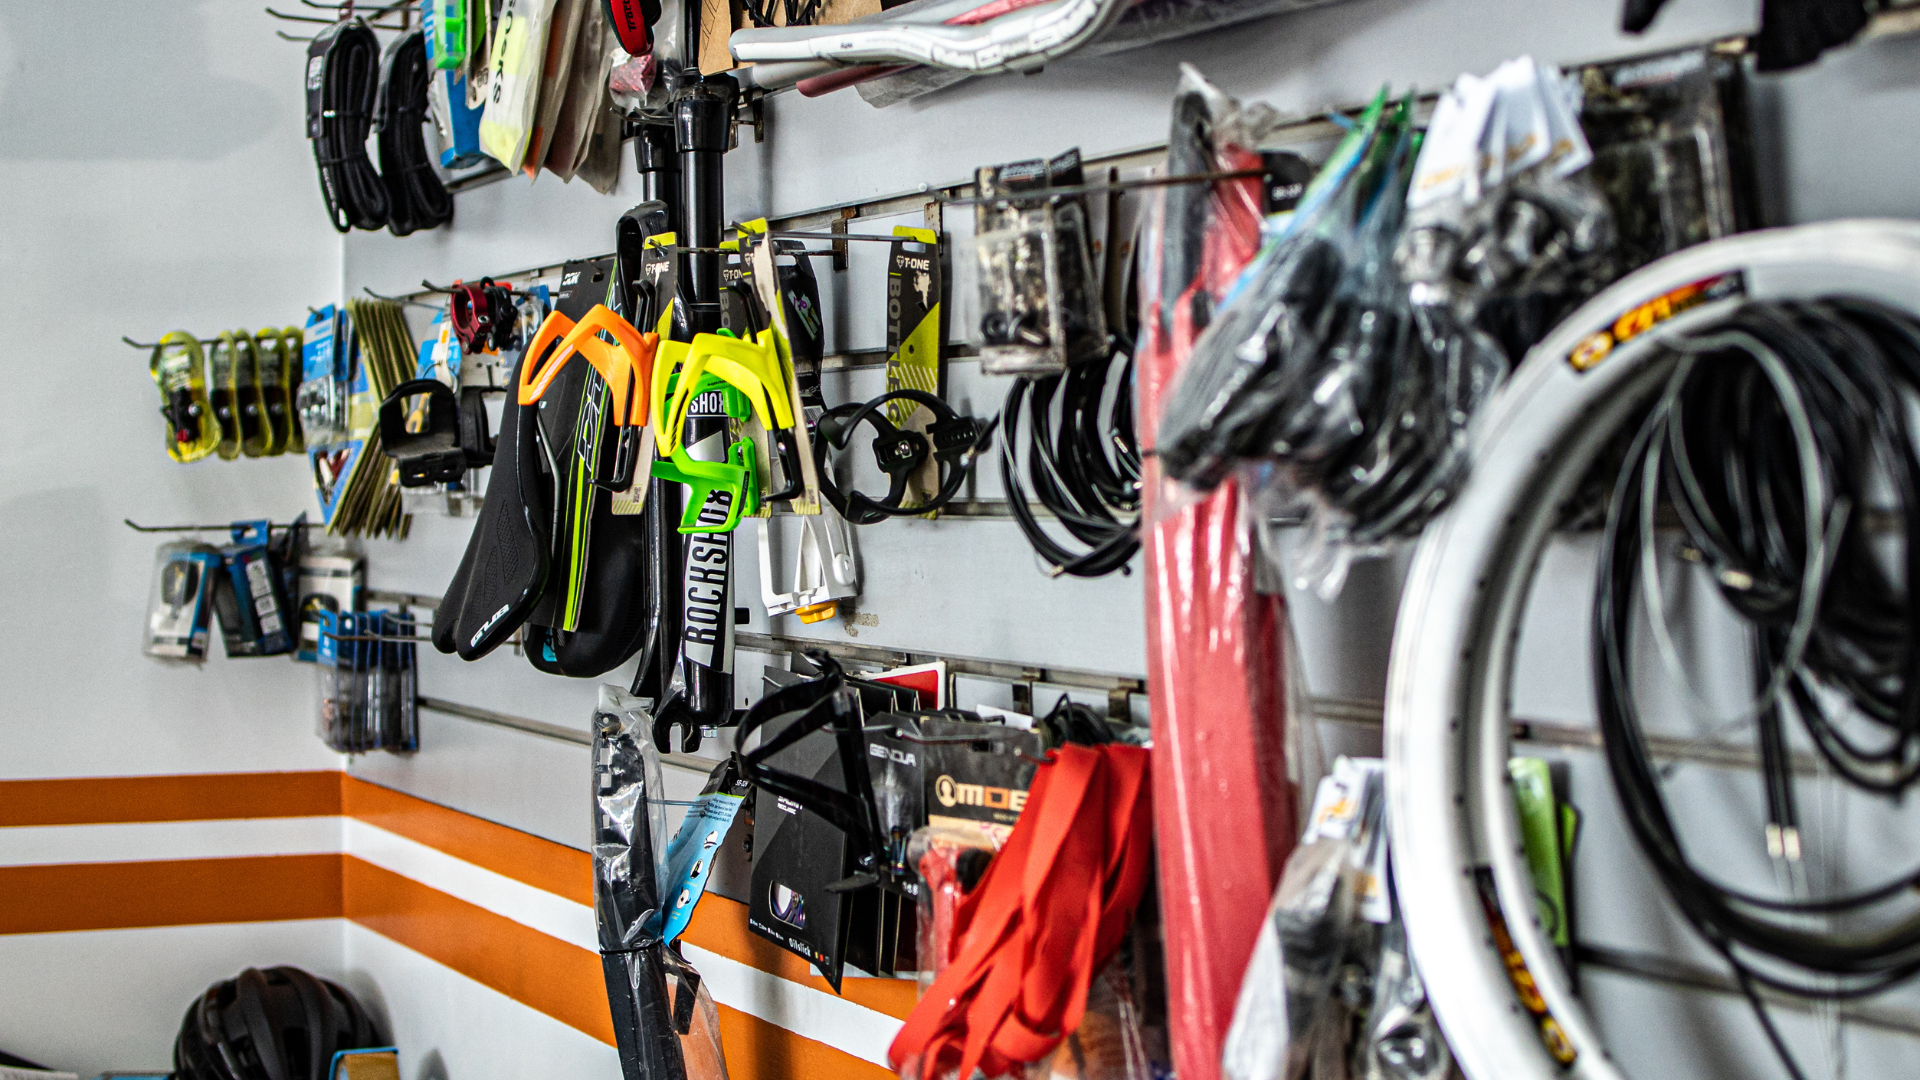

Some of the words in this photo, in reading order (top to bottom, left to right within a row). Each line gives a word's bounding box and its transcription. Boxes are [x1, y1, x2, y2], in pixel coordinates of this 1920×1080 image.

[904, 257, 930, 271] T-ONE
[888, 277, 901, 392] BOTTLE
[684, 489, 733, 645] ROCKSHOX
